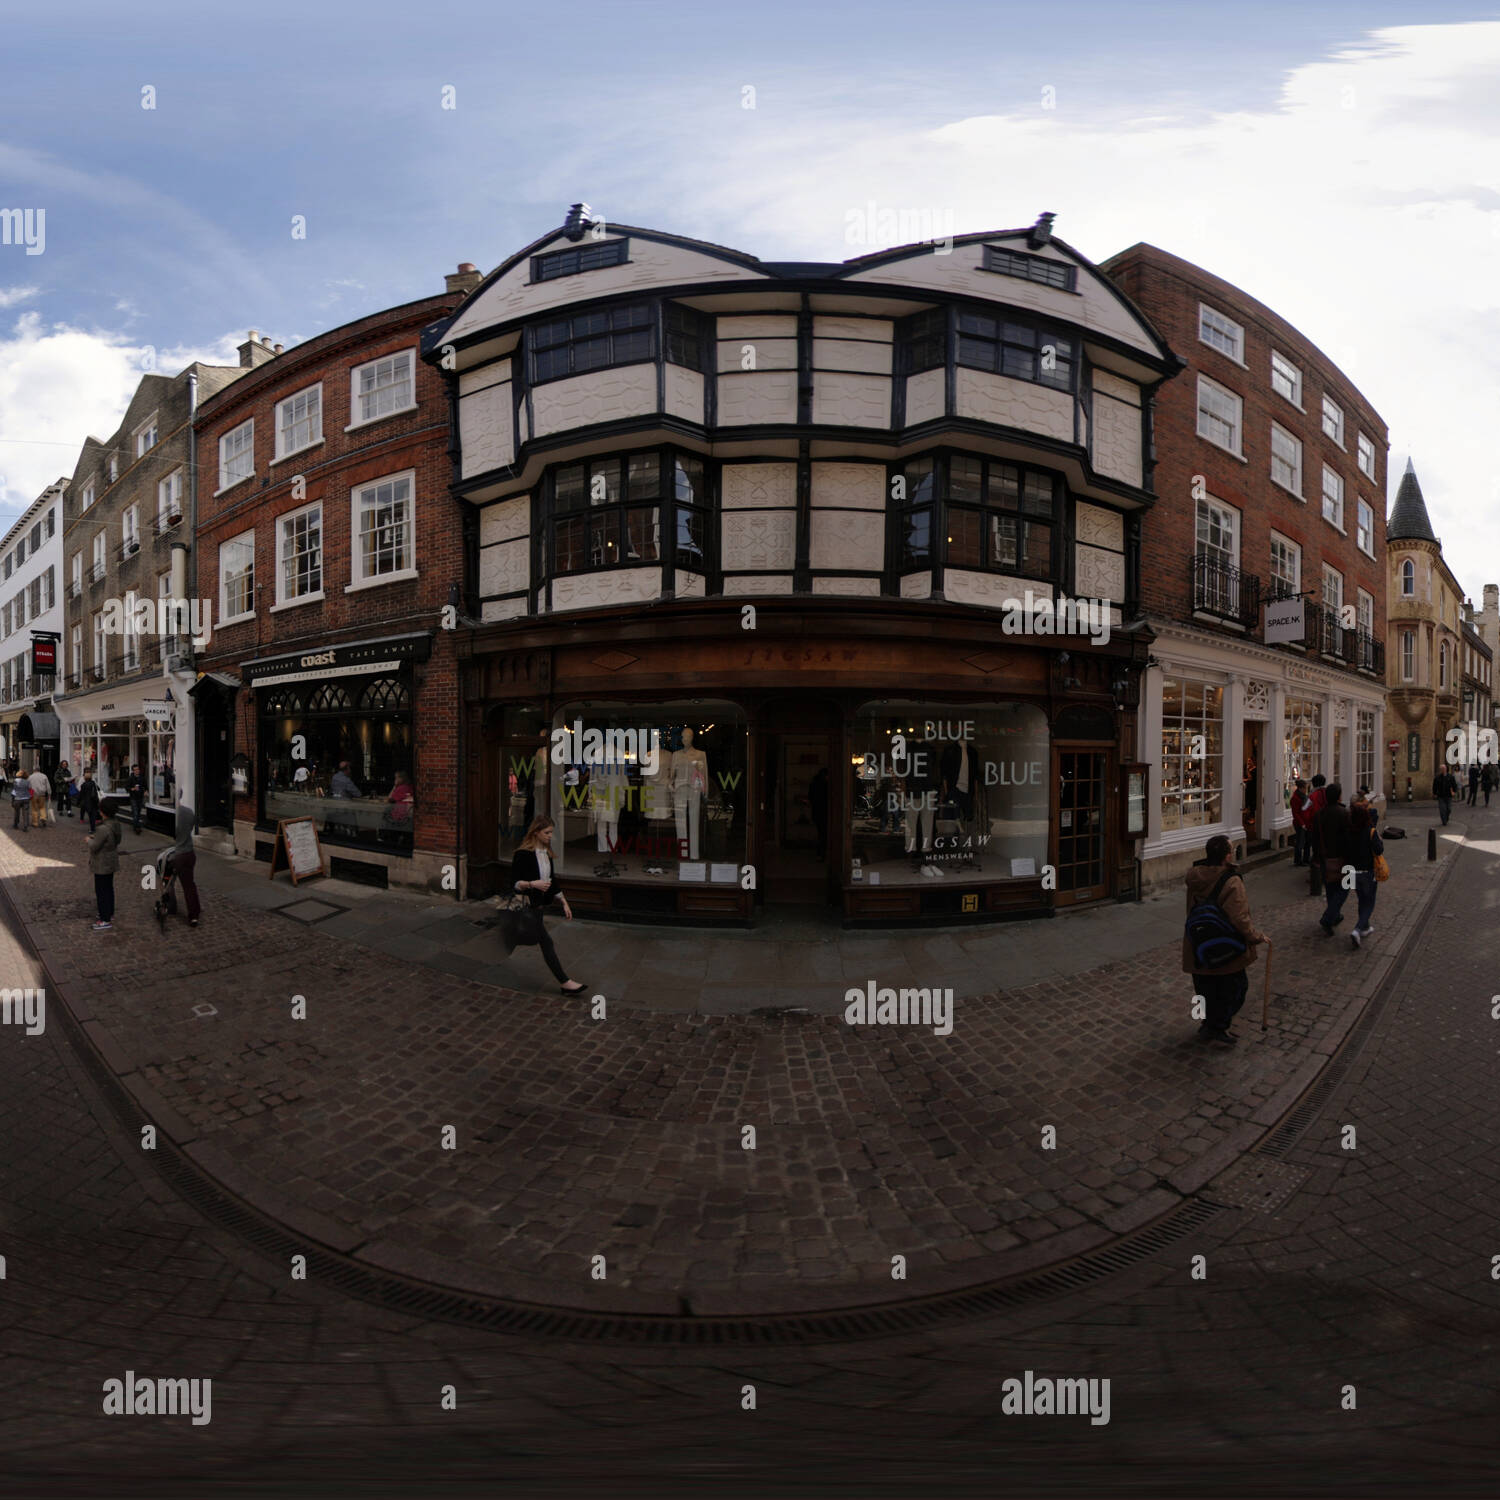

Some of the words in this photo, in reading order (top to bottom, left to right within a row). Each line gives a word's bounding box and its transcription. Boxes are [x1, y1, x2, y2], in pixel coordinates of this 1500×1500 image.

[300, 649, 336, 668] coast
[744, 647, 859, 666] JIGSAW
[924, 720, 976, 741] BLUE
[863, 752, 928, 778] BLUE
[984, 761, 1042, 787] BLUE
[559, 783, 656, 813] WHITE
[887, 791, 939, 812] BLUE
[605, 834, 690, 861] WHITE
[907, 834, 993, 853] JIGSAW
[925, 852, 974, 862] MENSWEAR
